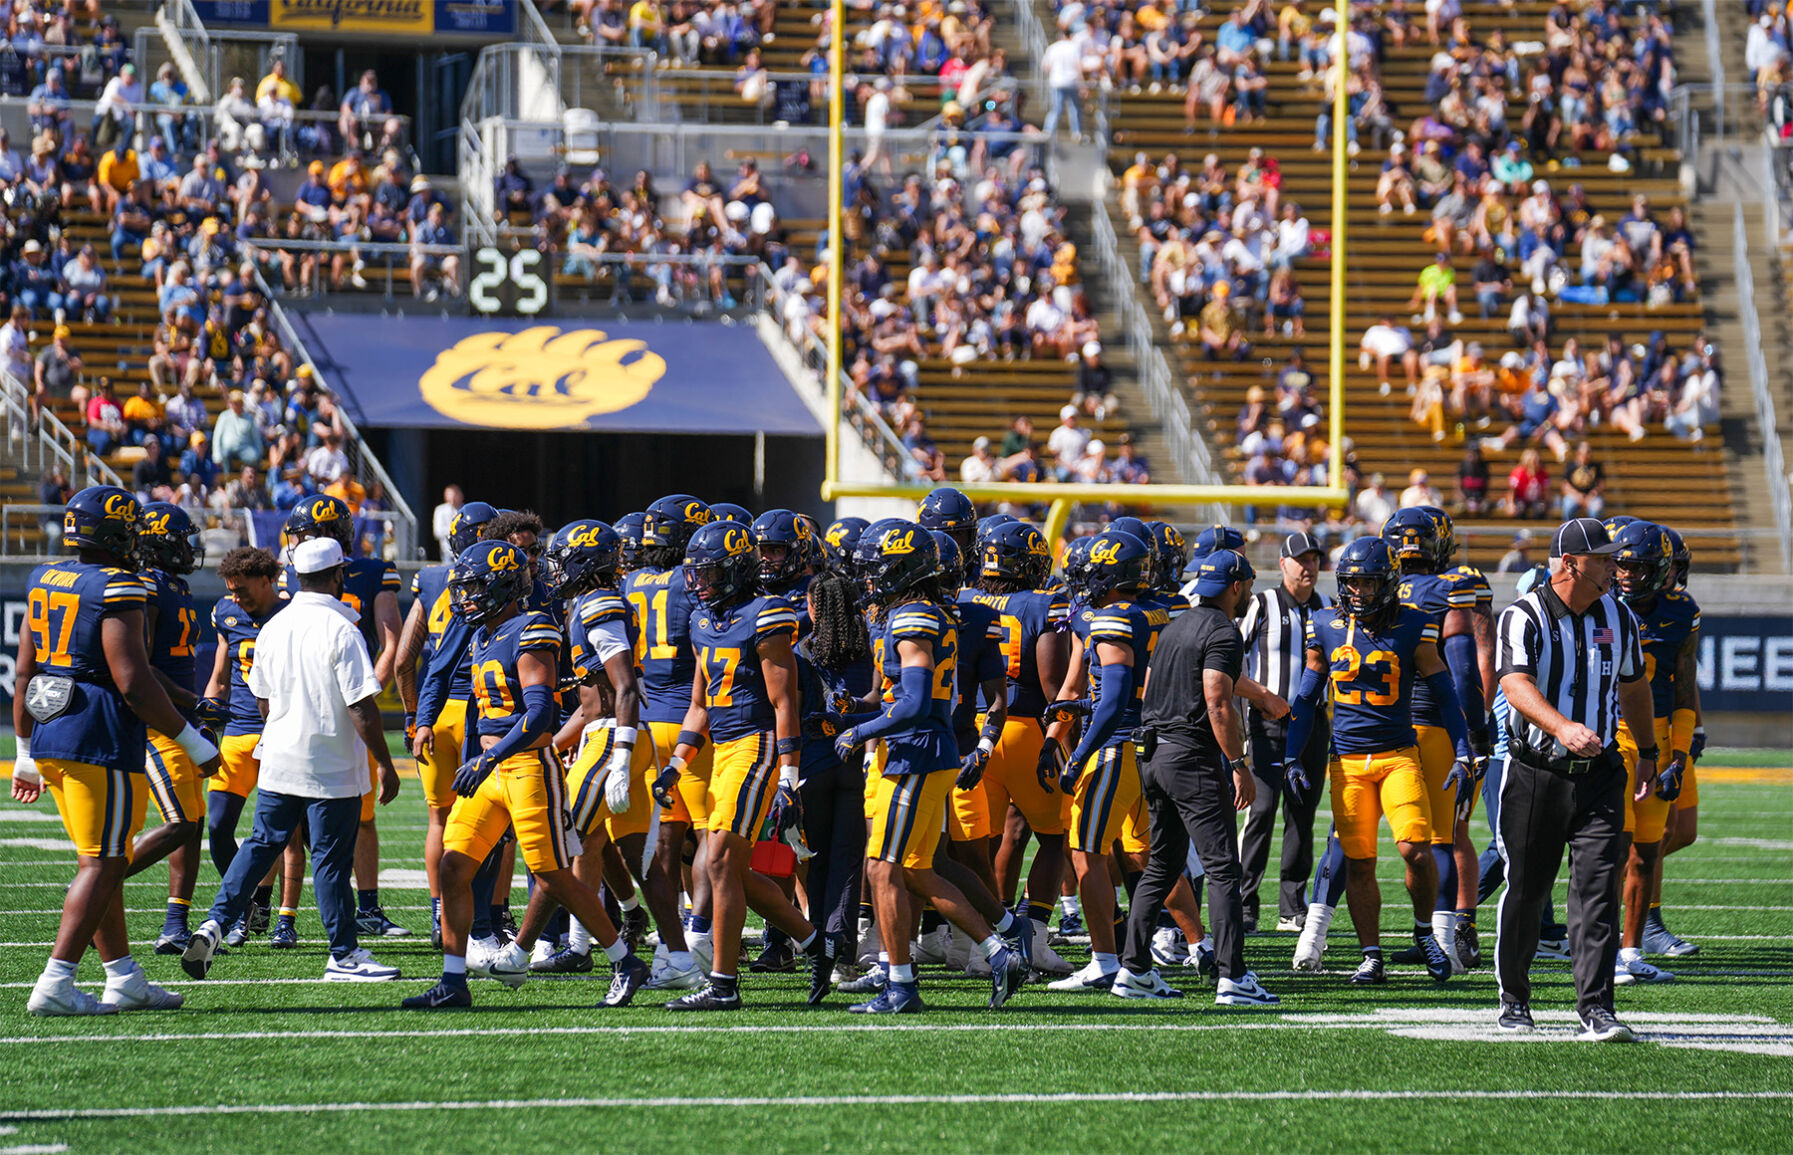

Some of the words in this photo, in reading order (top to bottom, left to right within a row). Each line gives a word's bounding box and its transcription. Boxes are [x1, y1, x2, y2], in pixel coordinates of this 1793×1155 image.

[470, 248, 548, 314] 25
[104, 494, 136, 522] Cal
[312, 500, 339, 524] Cal
[684, 502, 711, 526] Cal
[568, 525, 600, 547] Cal
[724, 529, 754, 557] Cal
[881, 529, 915, 556] Cal
[487, 547, 519, 572] Cal
[1089, 539, 1121, 565] Cal
[28, 587, 80, 667] 97
[1282, 615, 1290, 625] S
[1552, 630, 1560, 642] S
[1330, 645, 1401, 706] 23
[1601, 661, 1612, 676] H
